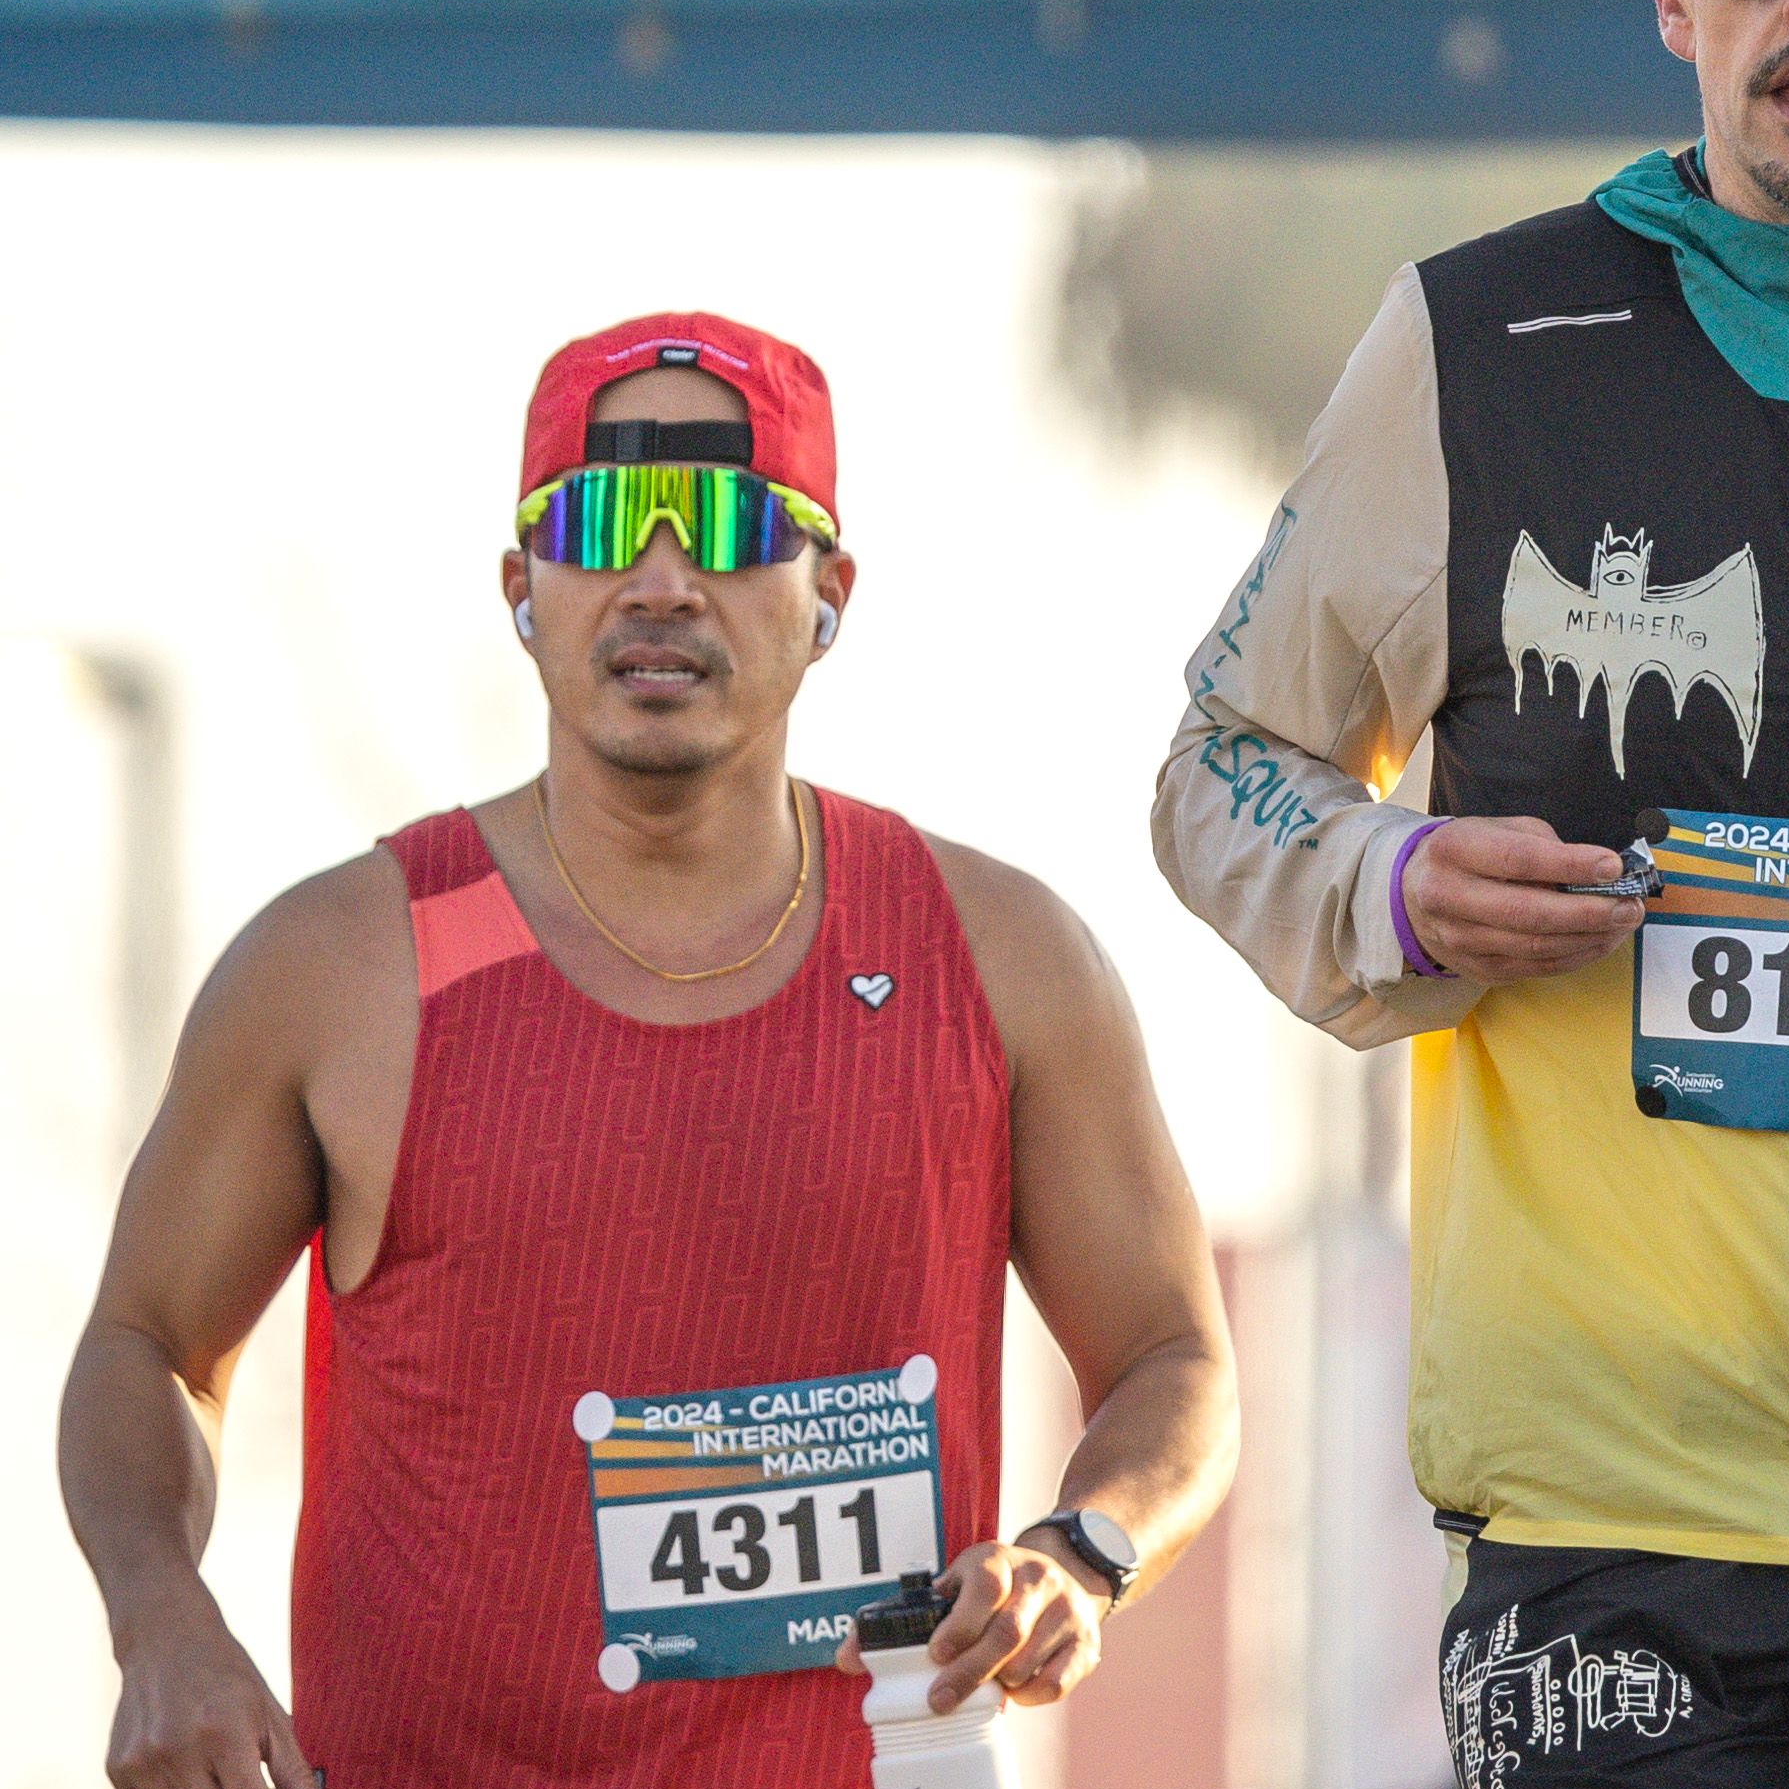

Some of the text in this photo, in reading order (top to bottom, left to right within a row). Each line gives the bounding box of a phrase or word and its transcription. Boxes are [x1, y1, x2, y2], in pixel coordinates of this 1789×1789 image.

[1566, 608, 1684, 642] MEMBER
[642, 1401, 724, 1431] 2024
[692, 1405, 927, 1457] INTERNATIONAL
[761, 1433, 930, 1479] MARATHON
[649, 1487, 882, 1596] 4311
